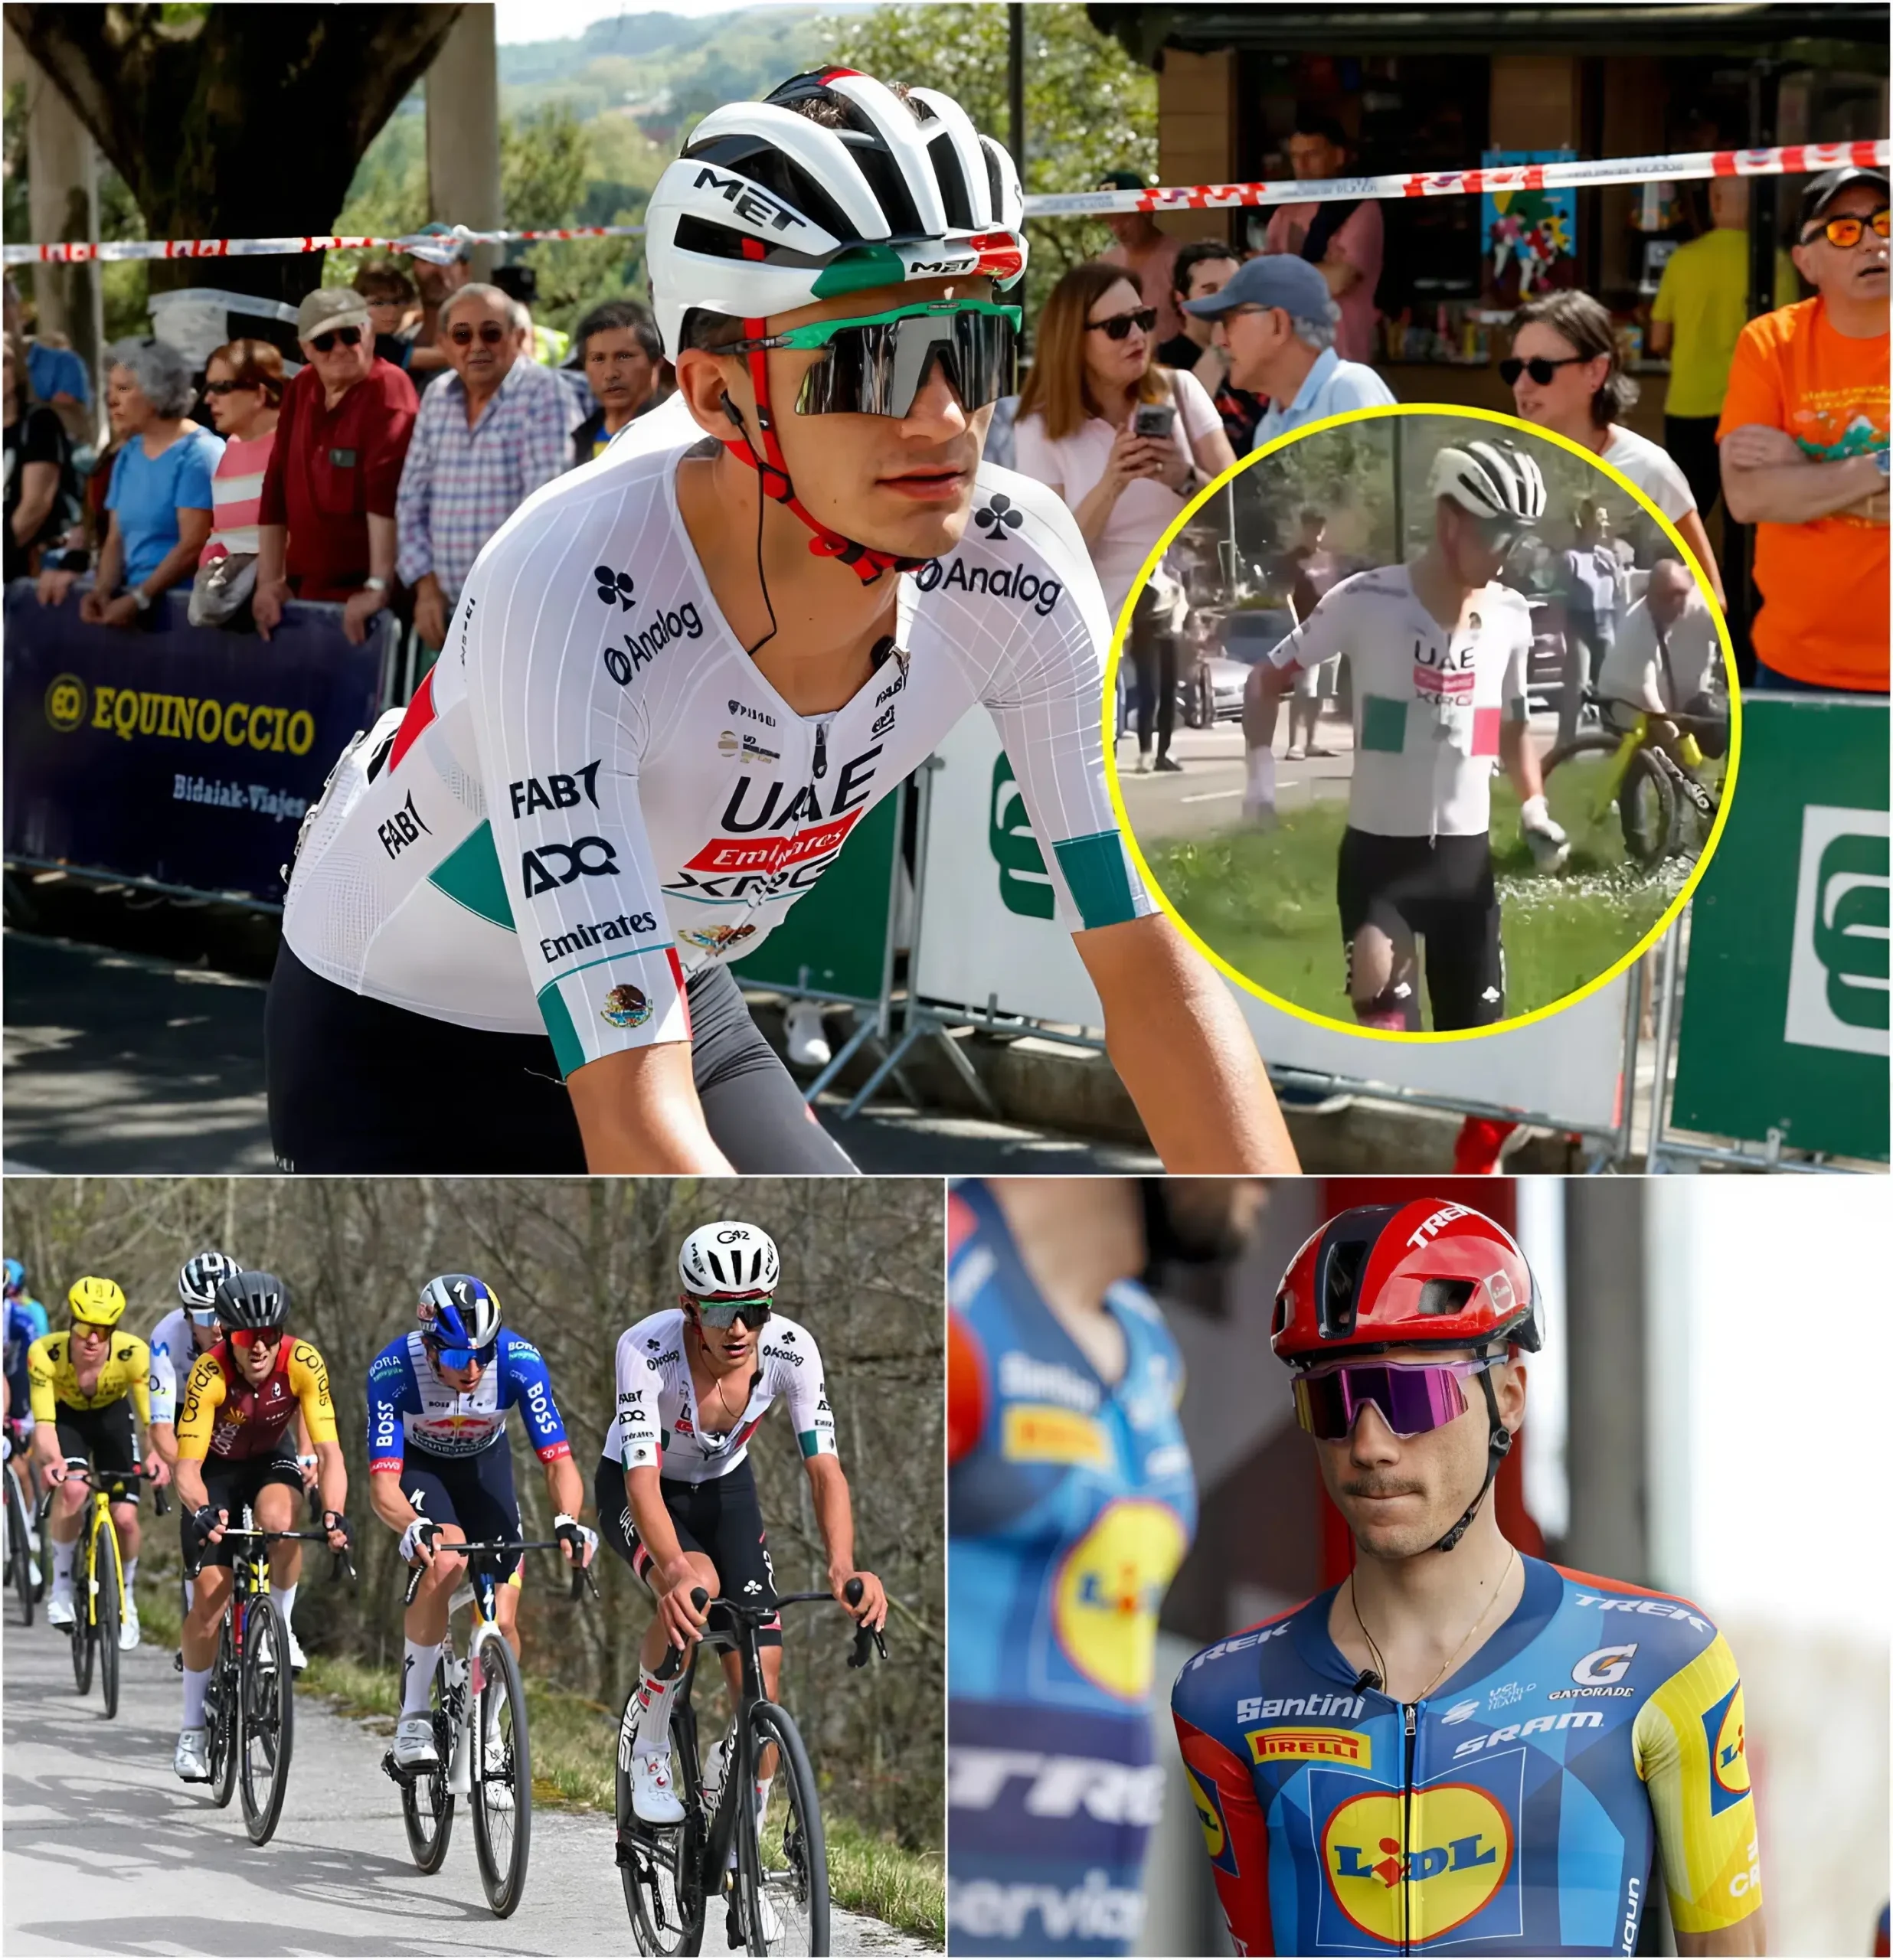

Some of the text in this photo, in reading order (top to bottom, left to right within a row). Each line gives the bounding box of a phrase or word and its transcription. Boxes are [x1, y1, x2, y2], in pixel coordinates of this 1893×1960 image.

[692, 167, 807, 231] MET
[909, 256, 976, 273] MET
[942, 557, 1063, 617] Analog
[623, 601, 704, 673] Analog
[1414, 639, 1476, 671] UAE
[90, 685, 316, 756] EQUINOCCIO
[720, 742, 884, 834] UAE
[522, 835, 621, 900] ADQ
[539, 910, 658, 964] Emirates
[376, 1400, 395, 1448] BOSS
[527, 1380, 558, 1435] BOSS
[1575, 1592, 1713, 1635] TREK
[1237, 1691, 1366, 1724] Santini
[1547, 1686, 1635, 1701] GATORADE
[1255, 1732, 1359, 1760] PIRELLI
[1453, 1710, 1605, 1760] SRAM
